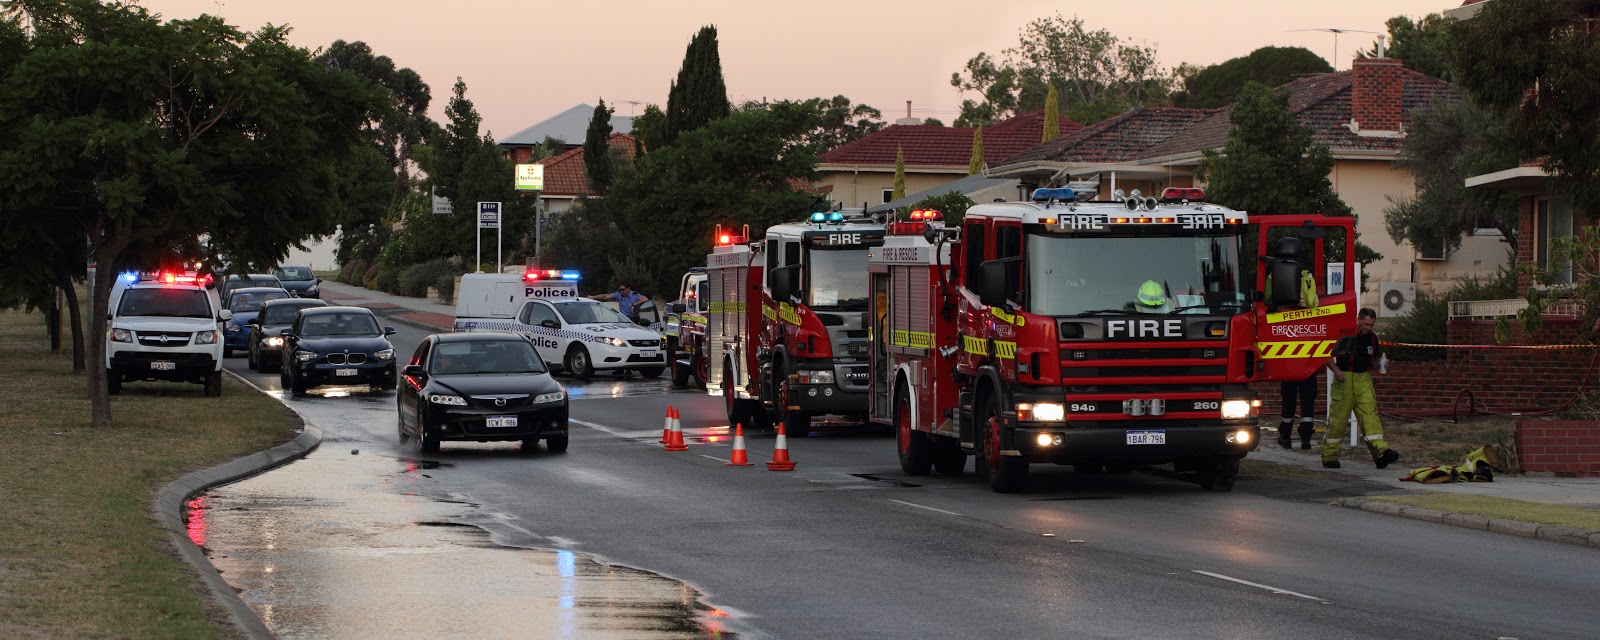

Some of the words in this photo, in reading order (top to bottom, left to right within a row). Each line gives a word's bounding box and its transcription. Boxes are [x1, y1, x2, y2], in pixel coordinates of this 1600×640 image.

[1060, 215, 1104, 230] FIRE
[829, 233, 862, 245] FIRE
[882, 247, 894, 261] FIRE
[899, 247, 918, 261] RESCUE
[1331, 271, 1342, 286] FOR
[525, 287, 569, 297] Police
[1282, 309, 1313, 321] PERTH
[1315, 308, 1331, 316] 2ND
[1107, 319, 1183, 338] FIRE
[1070, 403, 1096, 412] 94D
[1193, 401, 1219, 410] 260
